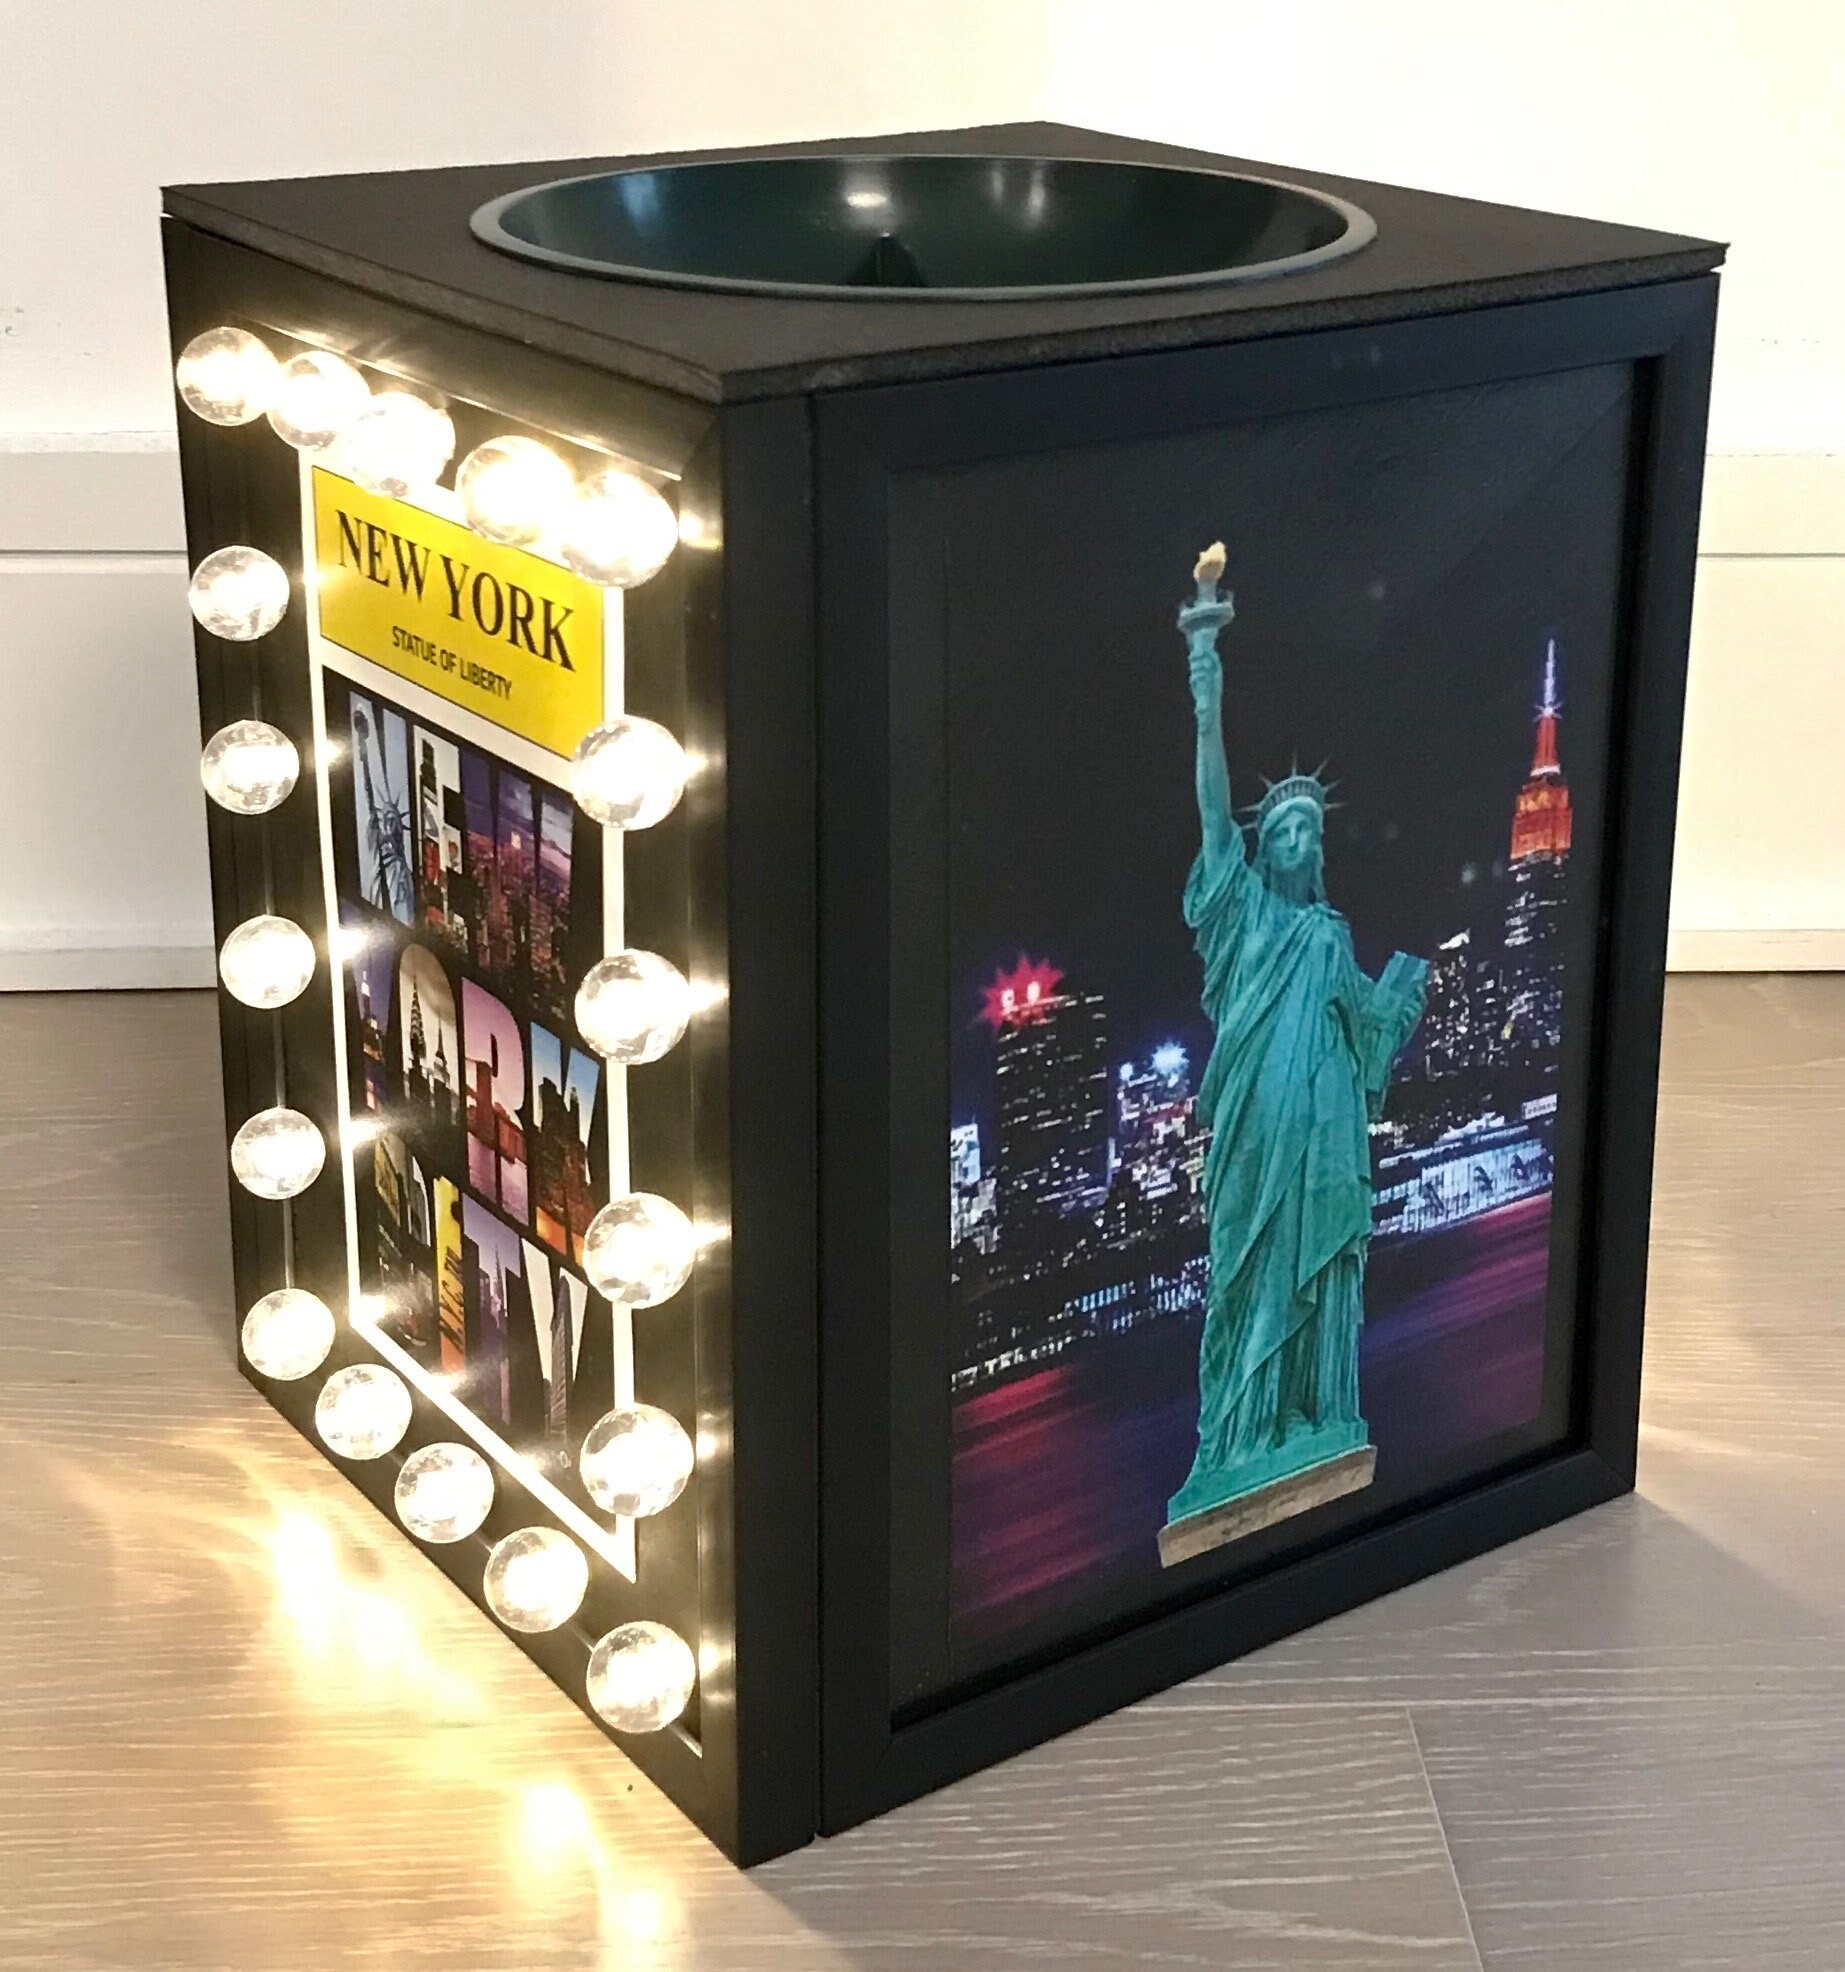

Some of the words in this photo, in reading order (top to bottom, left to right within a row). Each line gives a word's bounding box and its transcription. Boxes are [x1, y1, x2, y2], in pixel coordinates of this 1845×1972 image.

[336, 509, 431, 602] NEW
[440, 553, 576, 672] YORK
[392, 624, 437, 667] STATUE
[440, 648, 457, 673] OF
[460, 657, 513, 700] LIBERTY
[349, 689, 574, 1025] NEW
